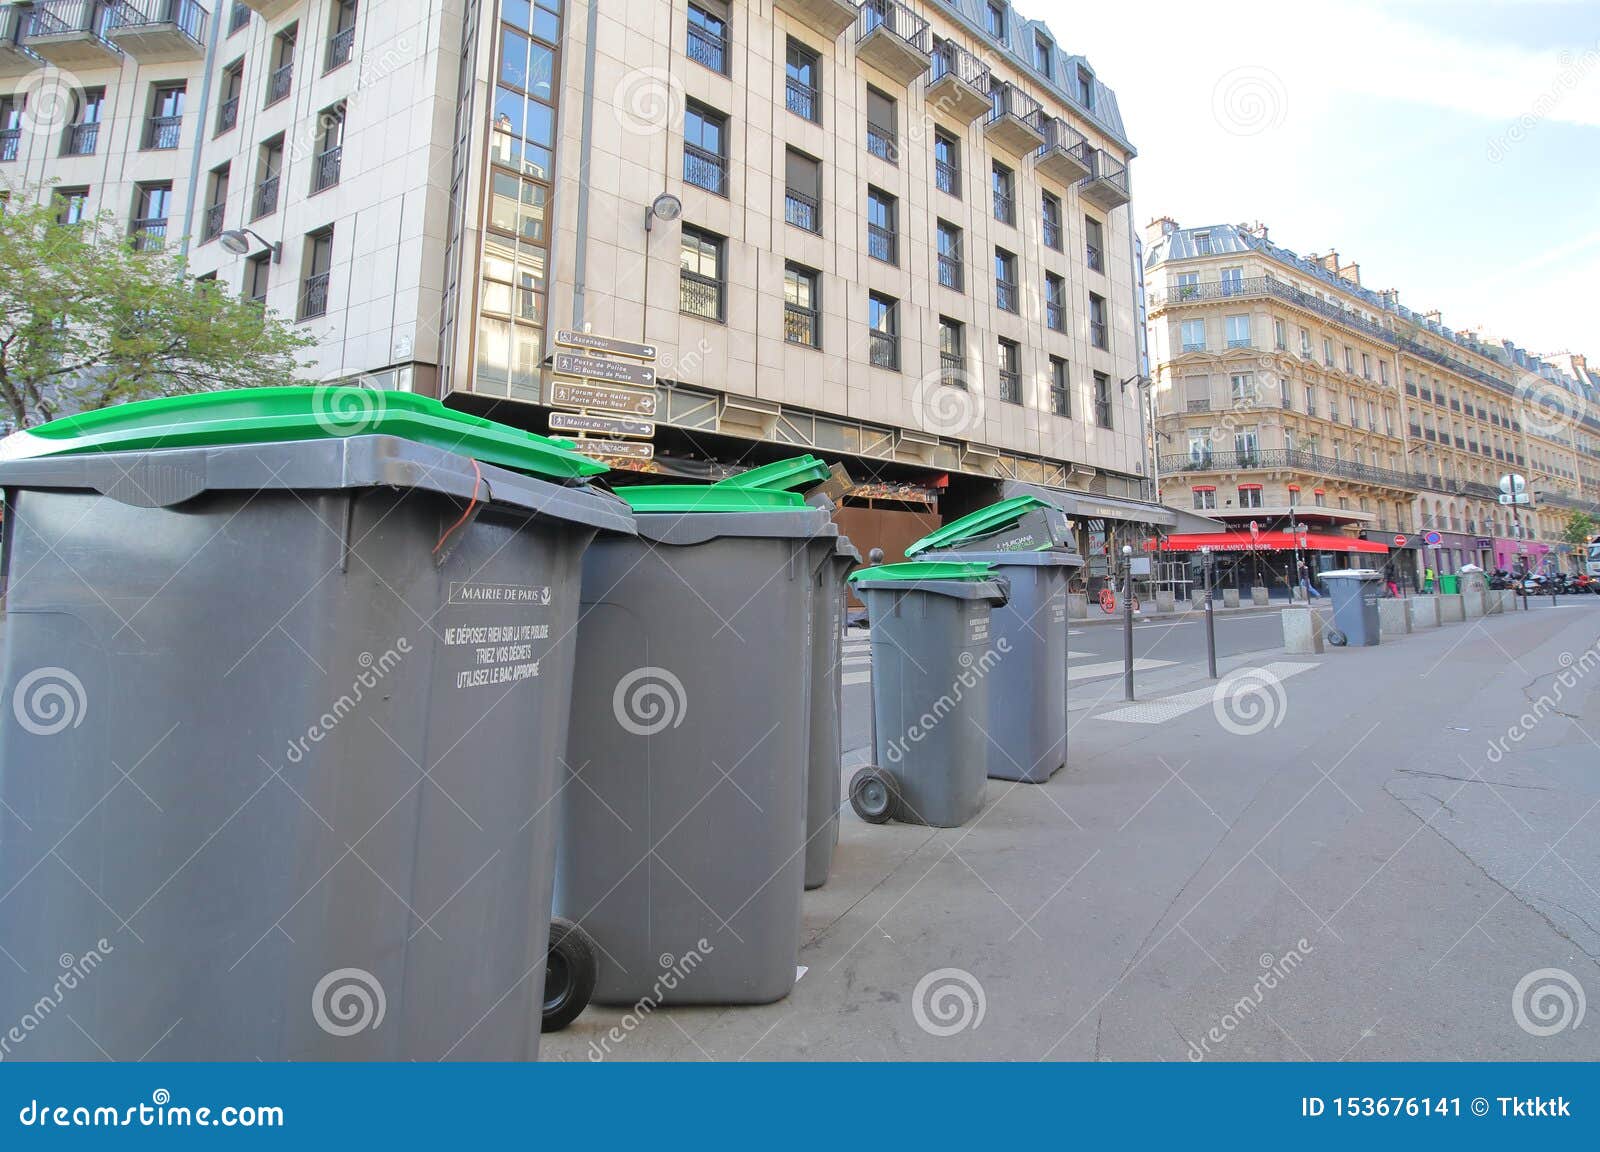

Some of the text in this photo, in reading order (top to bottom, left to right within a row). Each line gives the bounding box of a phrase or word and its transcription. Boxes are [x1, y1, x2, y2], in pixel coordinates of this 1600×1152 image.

[573, 336, 608, 347] Ascenseur
[574, 358, 593, 367] Poste
[606, 363, 627, 372] Police
[582, 368, 604, 376] Bureau
[614, 372, 632, 380] Poste
[570, 396, 590, 404] Porte
[592, 398, 608, 406] Pont
[571, 388, 631, 401] Forum des Halles
[566, 418, 590, 427] Mairie
[592, 420, 601, 428] du
[461, 587, 539, 601] MAIRIE DE PARIS
[444, 628, 455, 646] NE
[456, 624, 488, 645] DÉPOSEZ
[488, 627, 502, 643] RIEN
[502, 626, 514, 642] SUR
[514, 626, 520, 641] LA
[476, 642, 532, 664] TRIEZ VOS DÉCHETS
[456, 659, 540, 689] UTILISEZ LE BAC APPROPRIÉ
